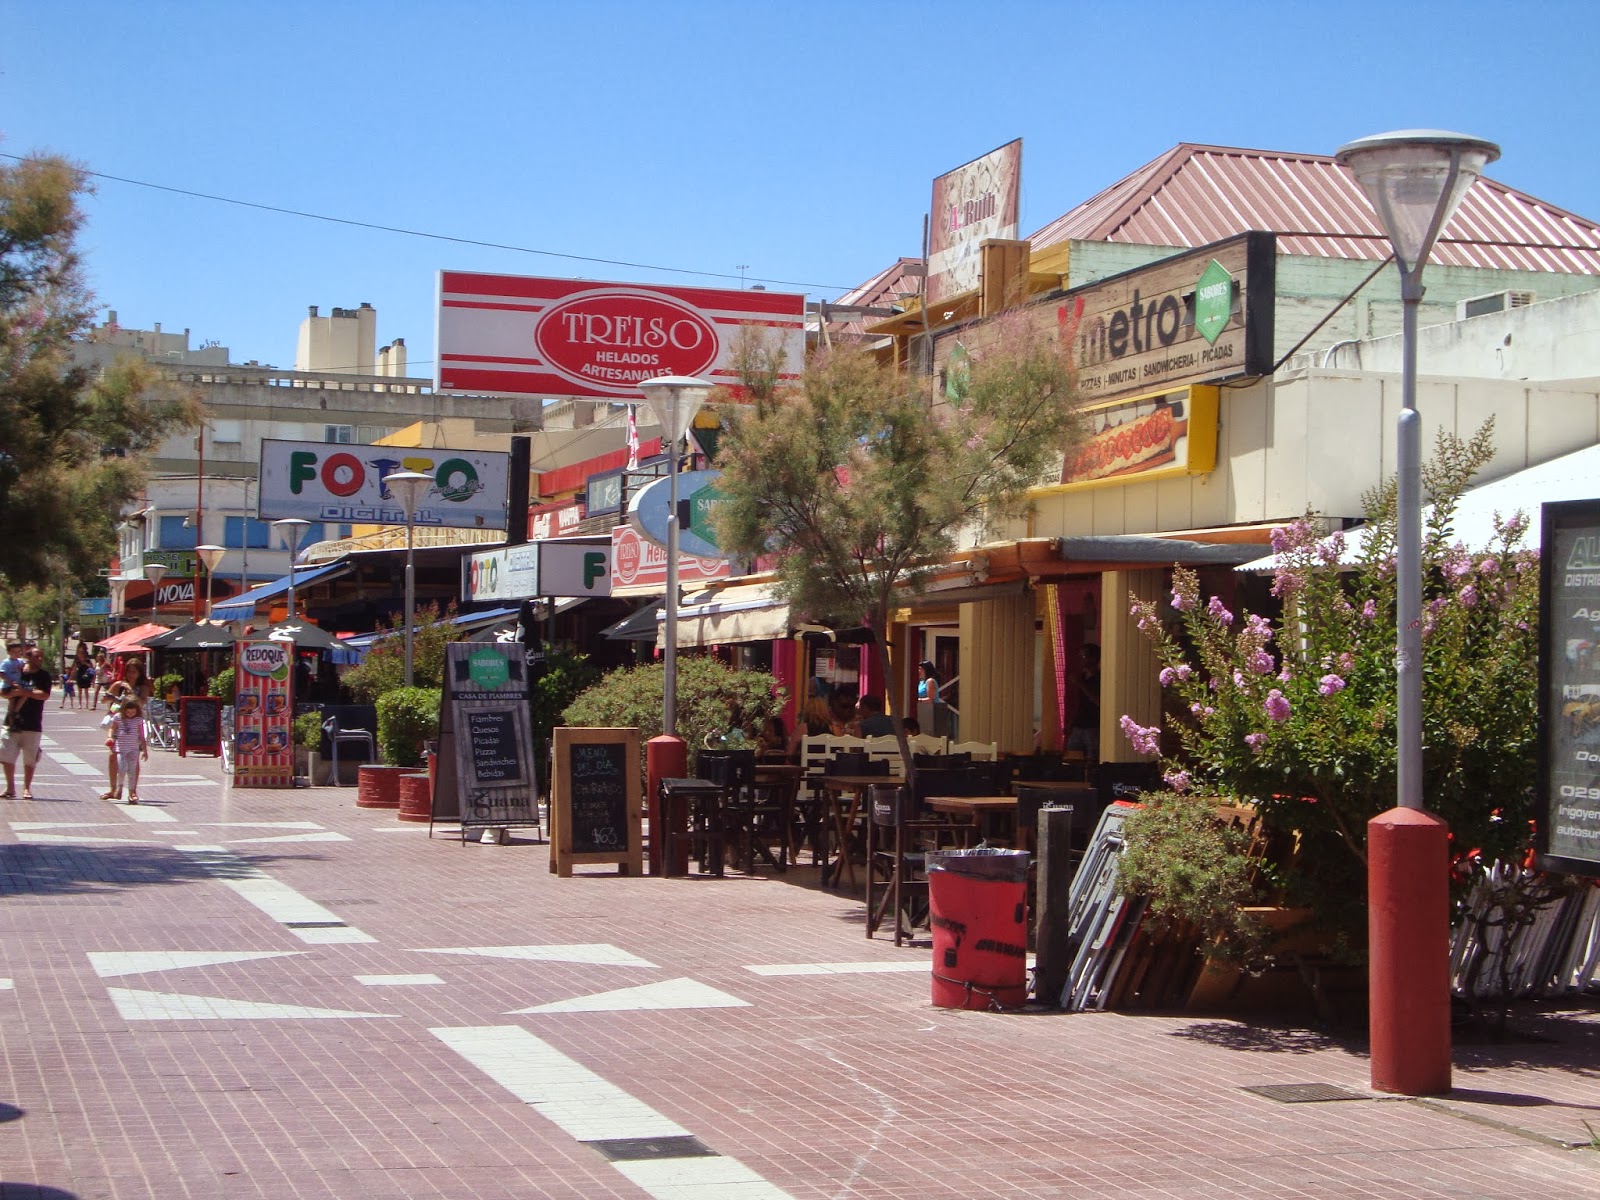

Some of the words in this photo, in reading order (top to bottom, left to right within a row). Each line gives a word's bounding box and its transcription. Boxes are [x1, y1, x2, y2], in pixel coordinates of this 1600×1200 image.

[964, 192, 996, 226] Ruth
[1200, 281, 1227, 301] SABORES
[562, 311, 701, 350] TREISO
[1202, 343, 1233, 363] PICADAS
[596, 351, 659, 365] HELADOS
[289, 451, 479, 502] FOTTO
[320, 506, 443, 524] DIGITAL
[146, 552, 182, 561] HOSTEL
[158, 582, 195, 604] NOVA
[472, 658, 505, 667] SABORES
[488, 692, 523, 700] FIAMBRES
[471, 714, 504, 723] Fiambres
[472, 726, 499, 735] Quesos
[474, 737, 500, 745] Picadas
[475, 748, 497, 756] Pizzas
[476, 757, 517, 766] Sandwiches
[478, 770, 505, 778] Bebidas
